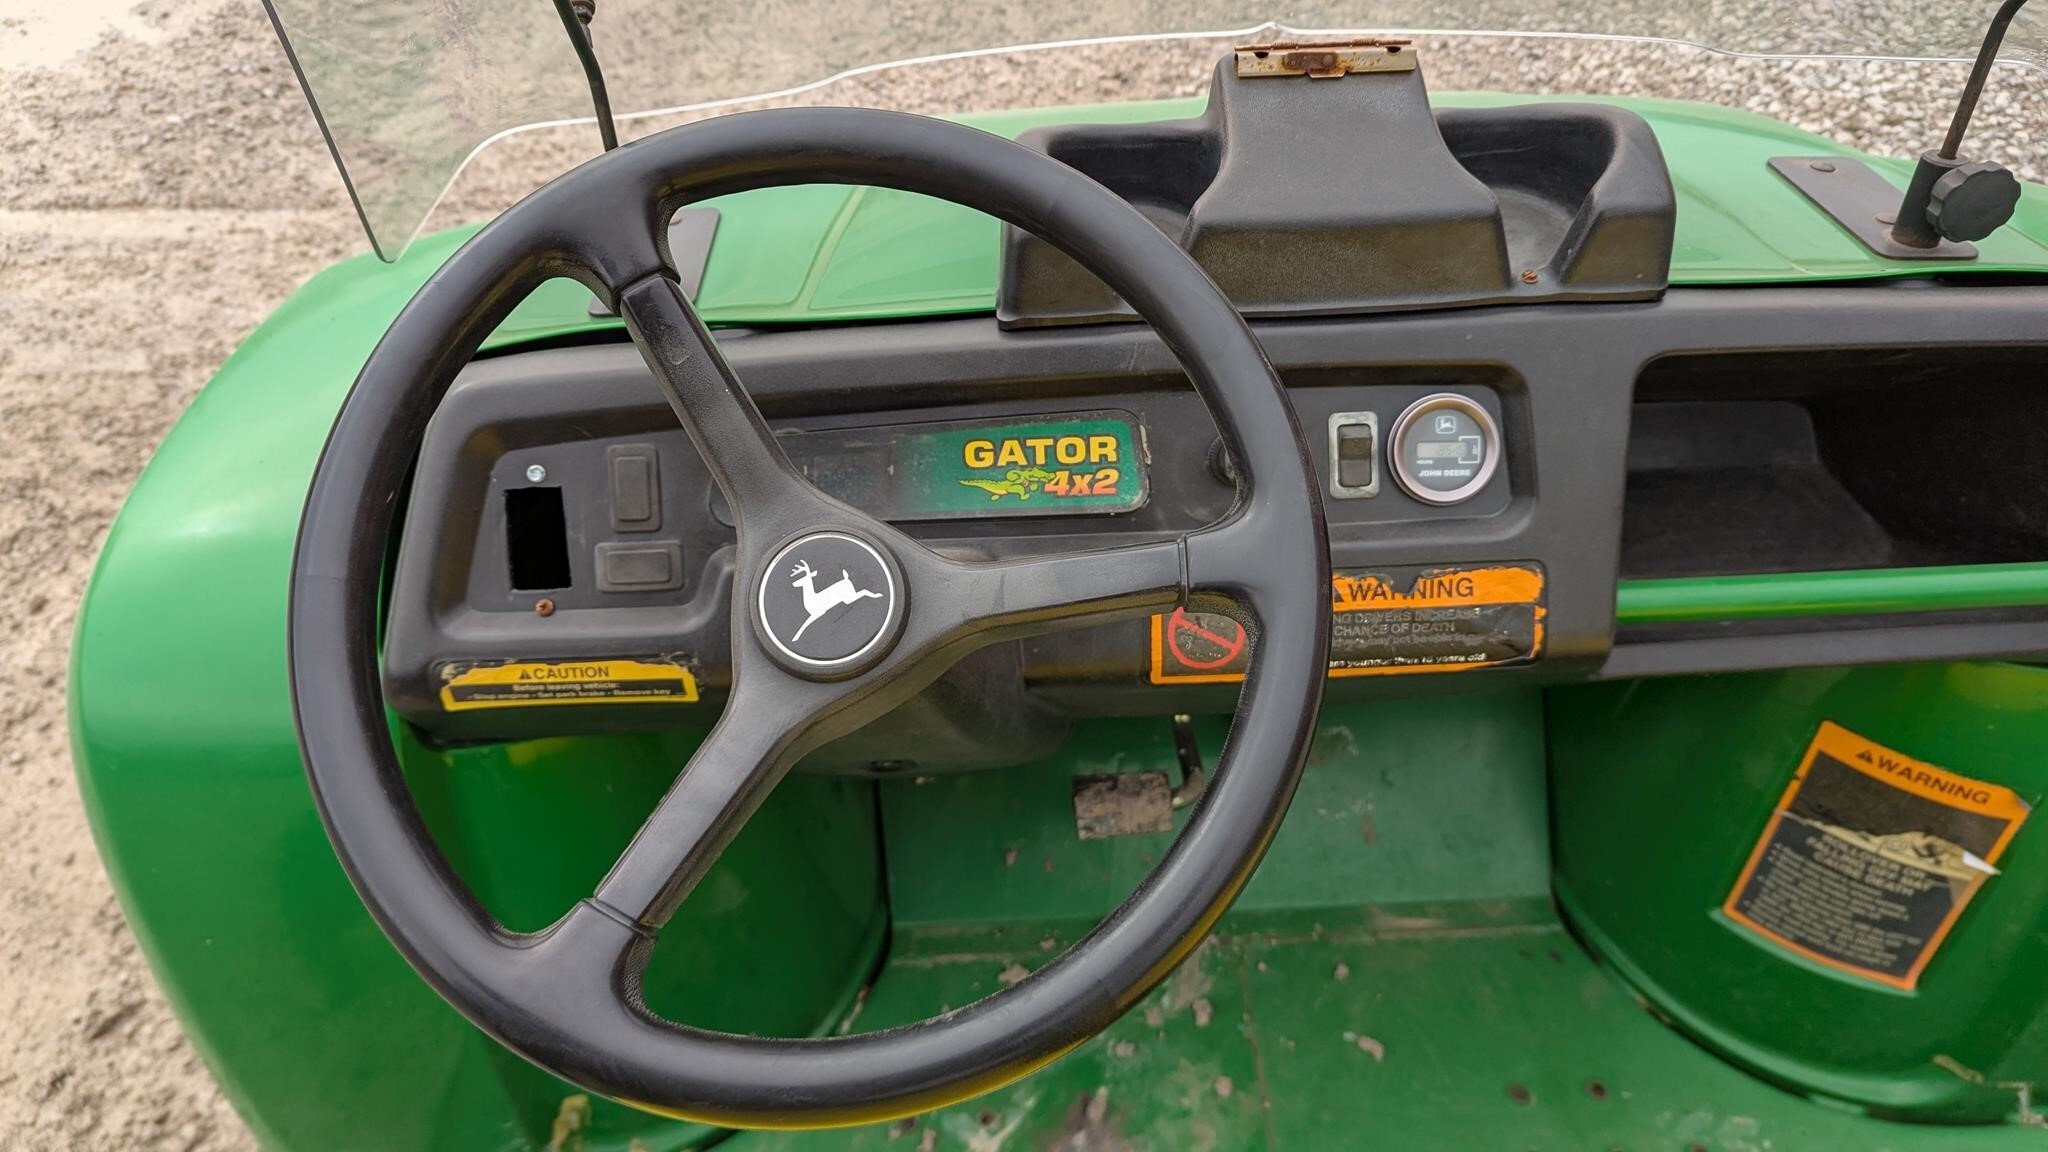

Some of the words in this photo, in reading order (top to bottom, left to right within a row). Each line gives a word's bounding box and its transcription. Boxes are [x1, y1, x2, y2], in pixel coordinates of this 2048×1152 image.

[964, 436, 1117, 468] GATOR
[1444, 469, 1471, 477] DEERE
[1044, 468, 1120, 497] 4x2
[1349, 576, 1475, 601] WANING
[1333, 622, 1390, 637] CHANCE
[1390, 621, 1410, 635] OF
[1411, 620, 1456, 635] DEATH
[533, 665, 610, 681] CAUTION
[512, 683, 545, 691] Before
[546, 683, 581, 691] leaving
[613, 688, 652, 696] Remove
[653, 687, 671, 696] key
[1877, 754, 1991, 806] WARNING
